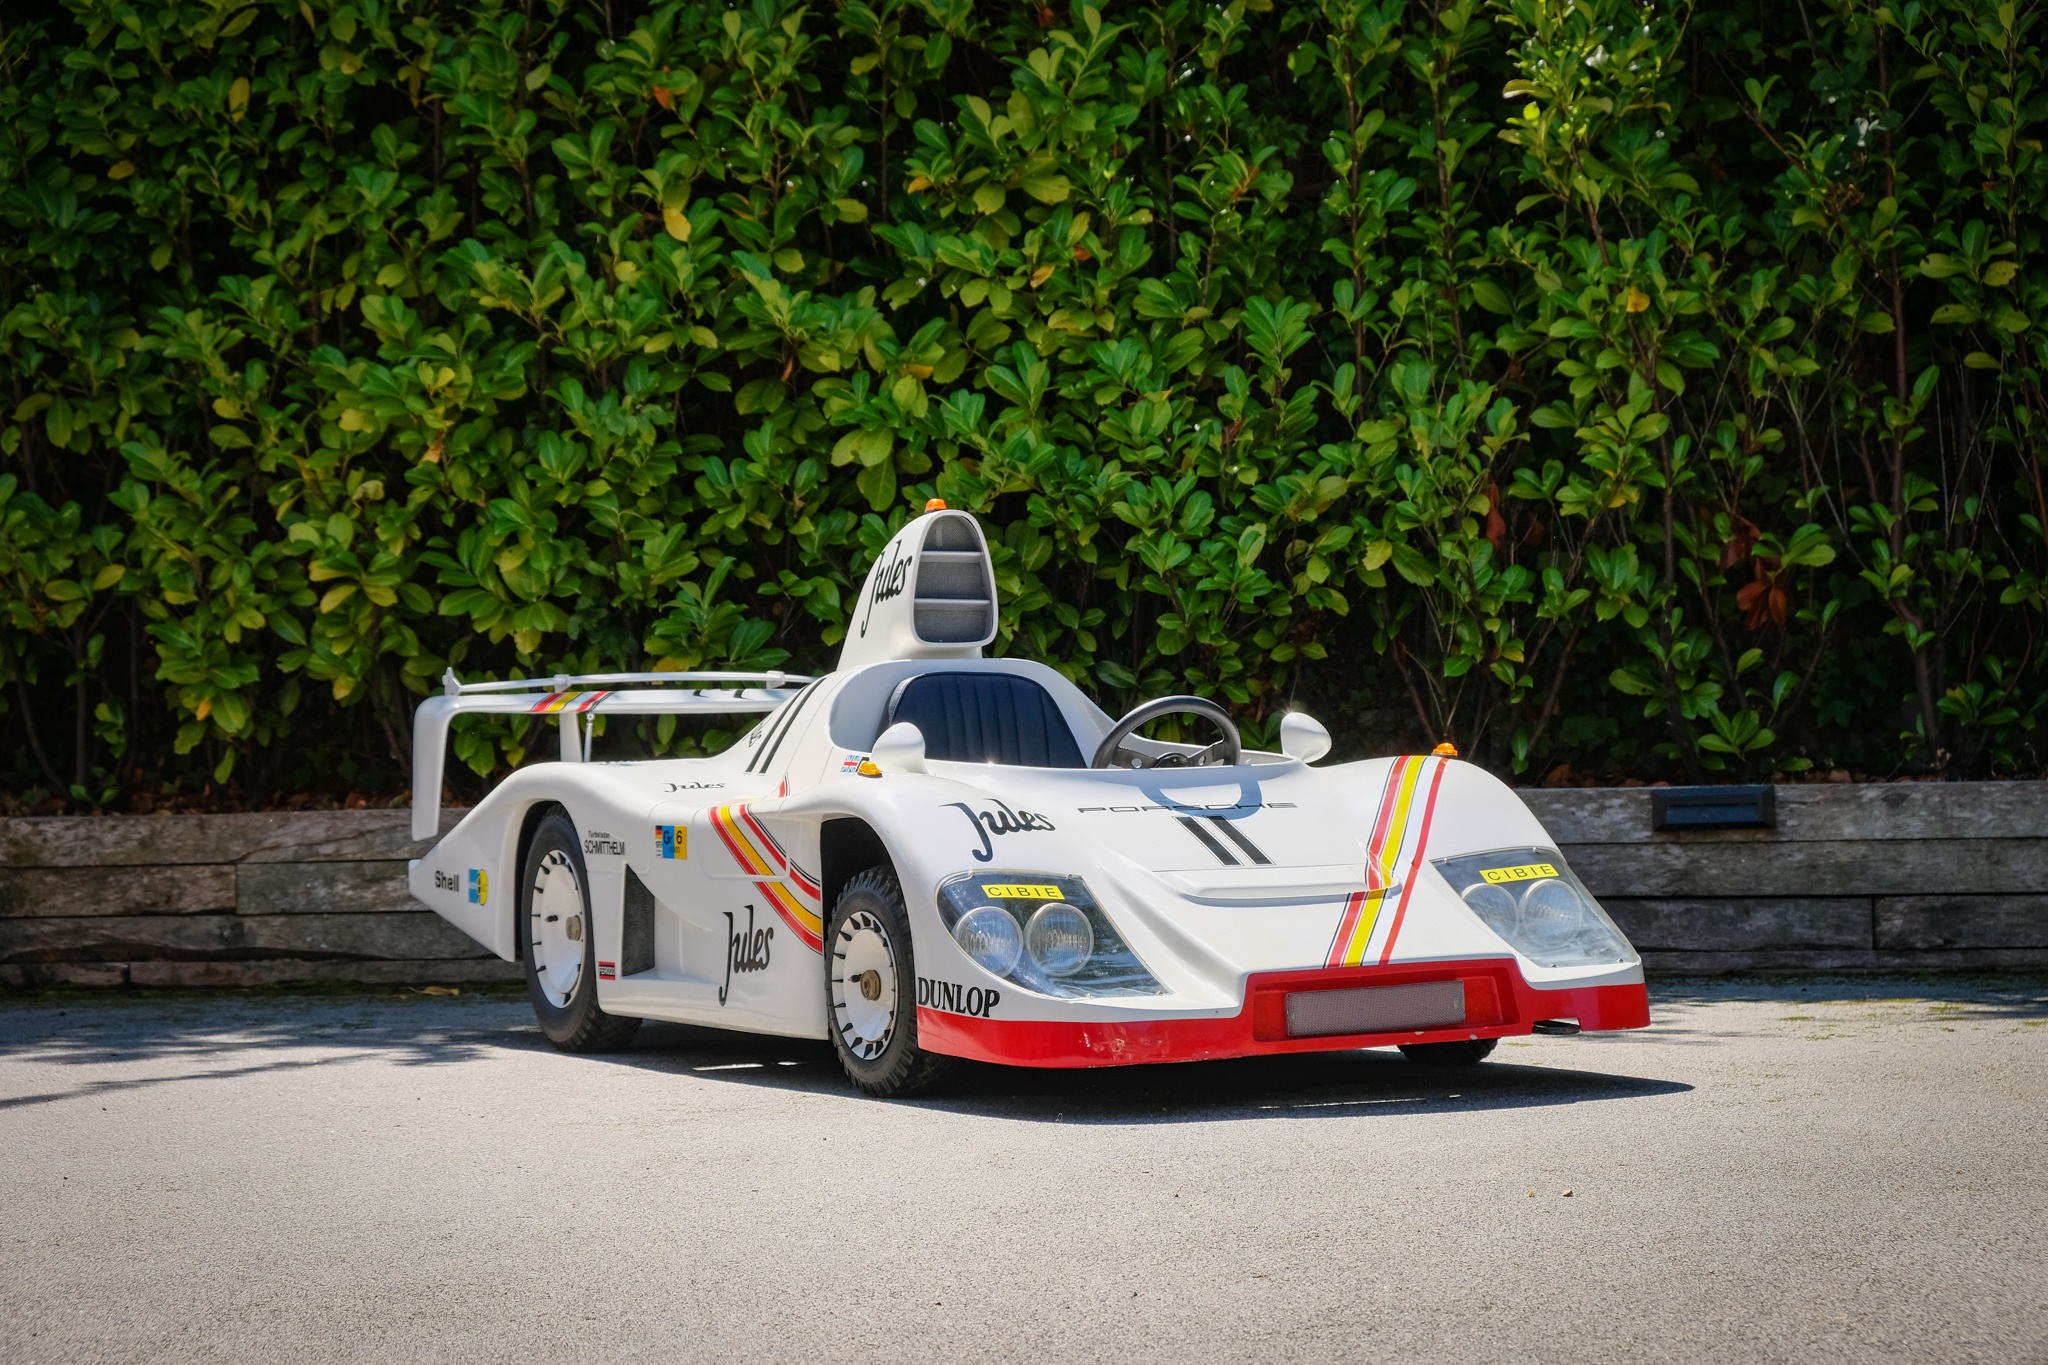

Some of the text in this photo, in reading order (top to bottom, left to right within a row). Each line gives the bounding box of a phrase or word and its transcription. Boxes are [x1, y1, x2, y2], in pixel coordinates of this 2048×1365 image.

[861, 538, 913, 639] Jules
[659, 781, 726, 793] Jules
[1077, 802, 1298, 813] PORSCHE
[663, 830, 683, 845] Gr 6
[937, 798, 1056, 862] Jules
[584, 839, 626, 856] SCHMITTHELM
[1171, 814, 1277, 867] 11
[434, 870, 459, 893] Shell
[1487, 865, 1554, 881] CIBIE
[988, 886, 1059, 898] CIBIE
[718, 904, 775, 1007] Jules
[917, 977, 1001, 1018] DUNLOP
